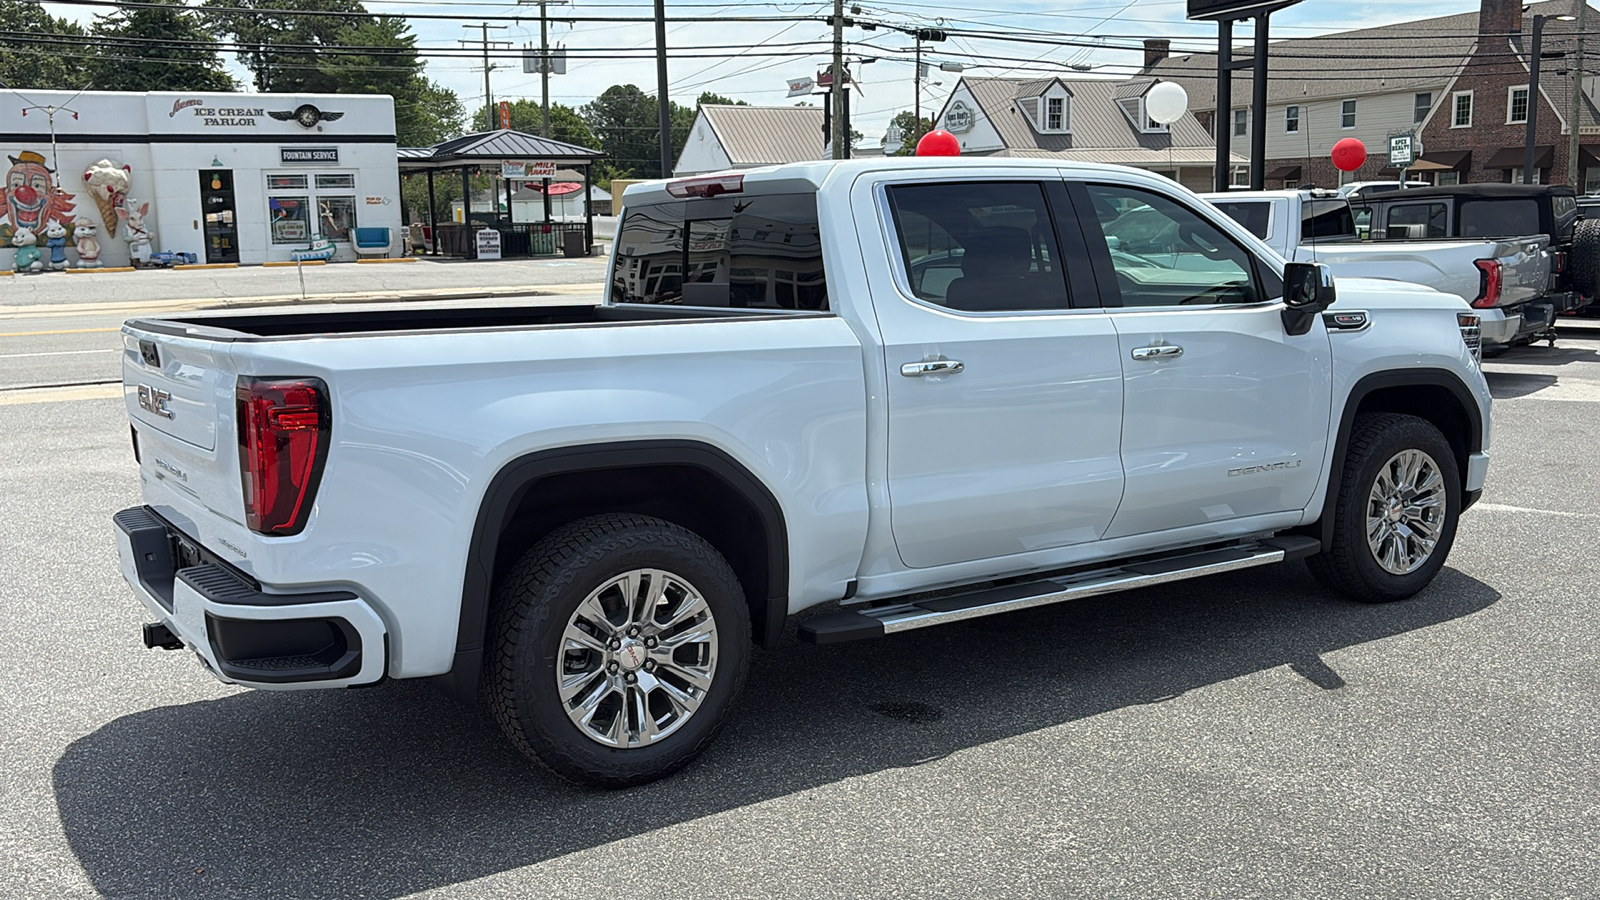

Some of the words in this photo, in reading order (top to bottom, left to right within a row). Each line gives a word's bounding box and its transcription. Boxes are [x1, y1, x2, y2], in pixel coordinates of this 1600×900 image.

[194, 108, 215, 116] ICE
[218, 108, 264, 116] CREAM
[501, 103, 509, 127] ACM
[204, 118, 256, 126] PARLOR
[283, 151, 312, 160] FOUNTAIN
[312, 151, 337, 160] SERVICE
[1227, 459, 1302, 477] DENALI
[627, 645, 640, 667] GMC
